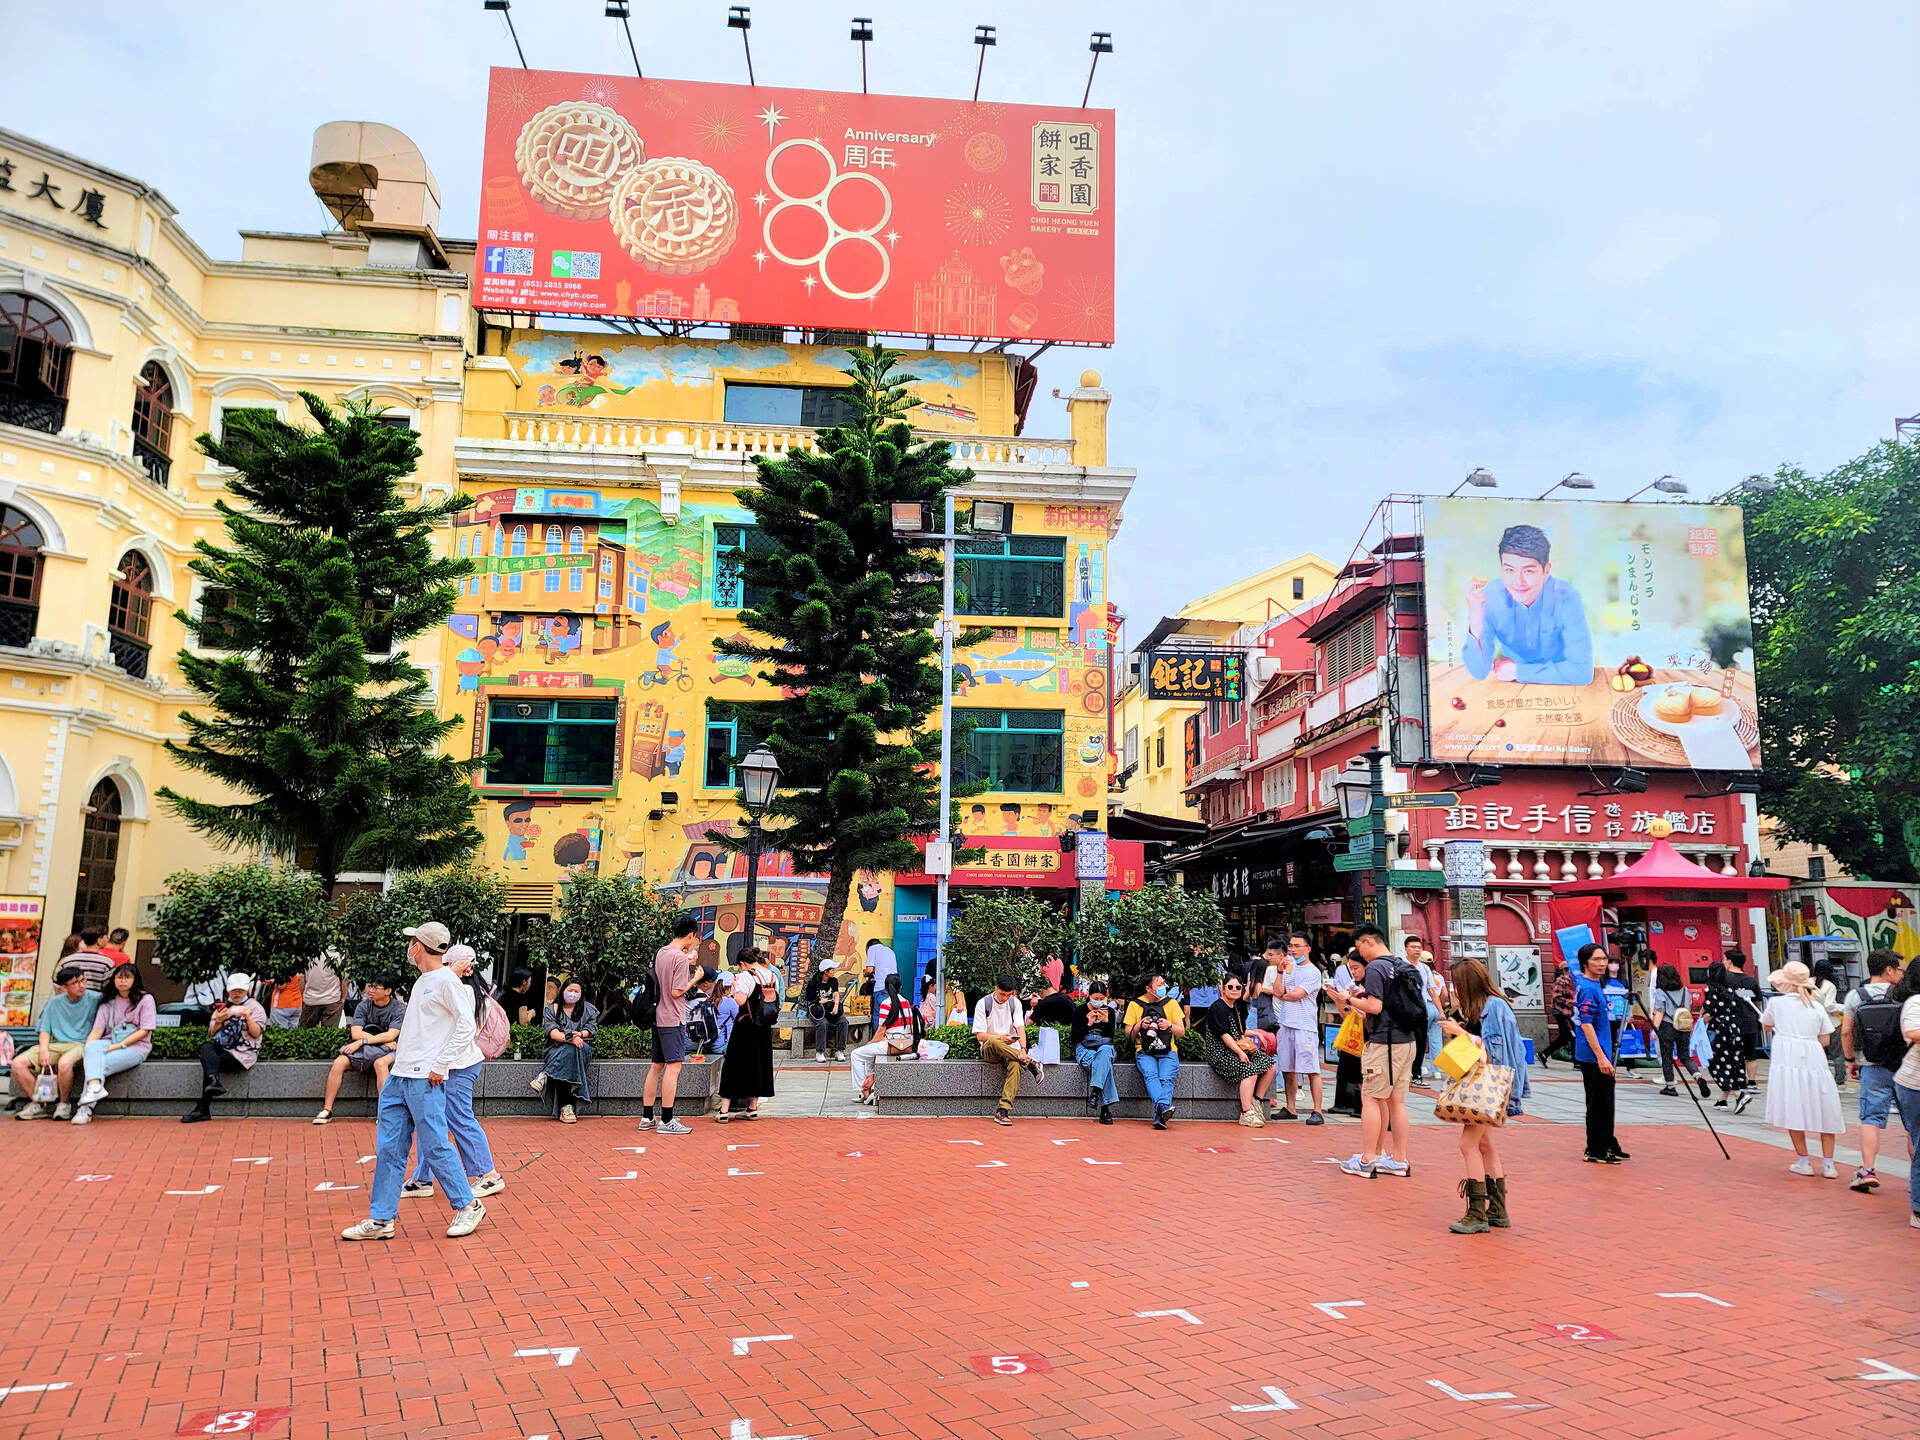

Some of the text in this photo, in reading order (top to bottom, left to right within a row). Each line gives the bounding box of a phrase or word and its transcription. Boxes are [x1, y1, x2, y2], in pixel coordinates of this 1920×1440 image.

[844, 127, 935, 148] Anniversary
[843, 145, 893, 170] 周年
[1038, 128, 1063, 177] 餅家
[1068, 131, 1094, 207] 咀香園
[647, 184, 709, 231] 香
[1030, 216, 1099, 227] CHOI HEONG YUEN
[1030, 225, 1062, 233] BAKERY
[482, 295, 504, 303] Email
[533, 298, 607, 309] enquiry@chyb.com
[483, 286, 514, 295] Website
[540, 290, 598, 299] www.chyb.com
[1045, 504, 1107, 529] 新中央
[1150, 657, 1211, 690] 鉅記
[1444, 802, 1598, 834] 鉅記手信
[1555, 1323, 1606, 1340] 2
[991, 1355, 1027, 1375] 5
